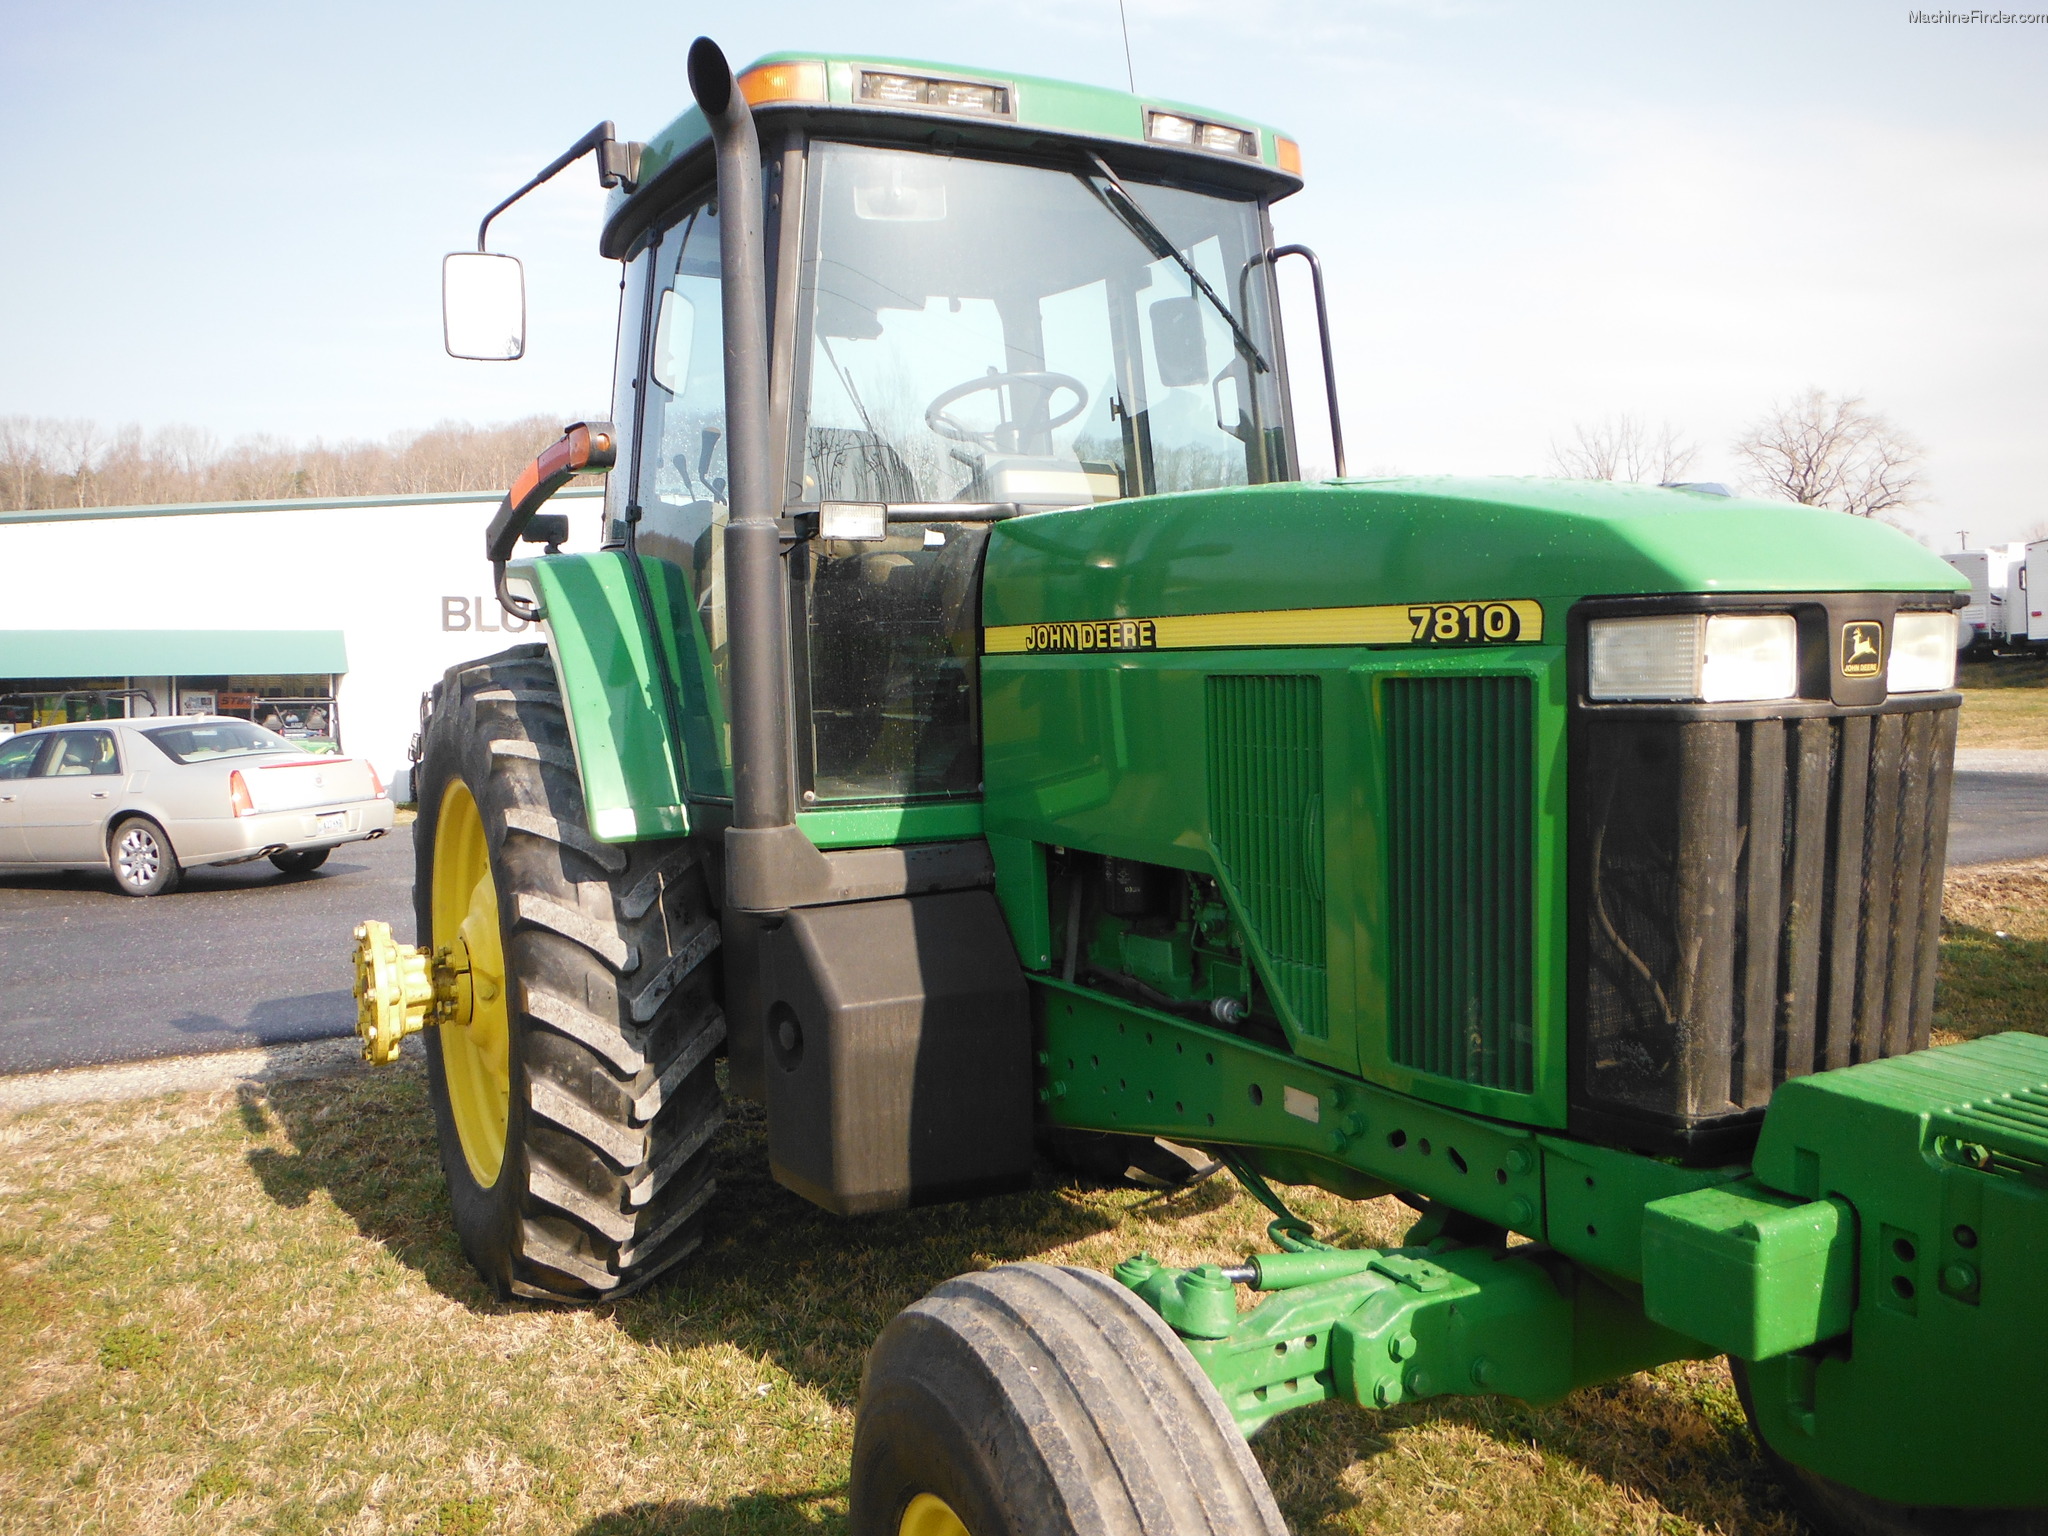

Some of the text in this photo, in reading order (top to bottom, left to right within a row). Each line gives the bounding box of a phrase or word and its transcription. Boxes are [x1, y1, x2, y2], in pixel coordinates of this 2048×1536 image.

[441, 596, 546, 633] BLU
[1408, 603, 1520, 642] 7810
[1026, 620, 1156, 651] JOHN DEERE
